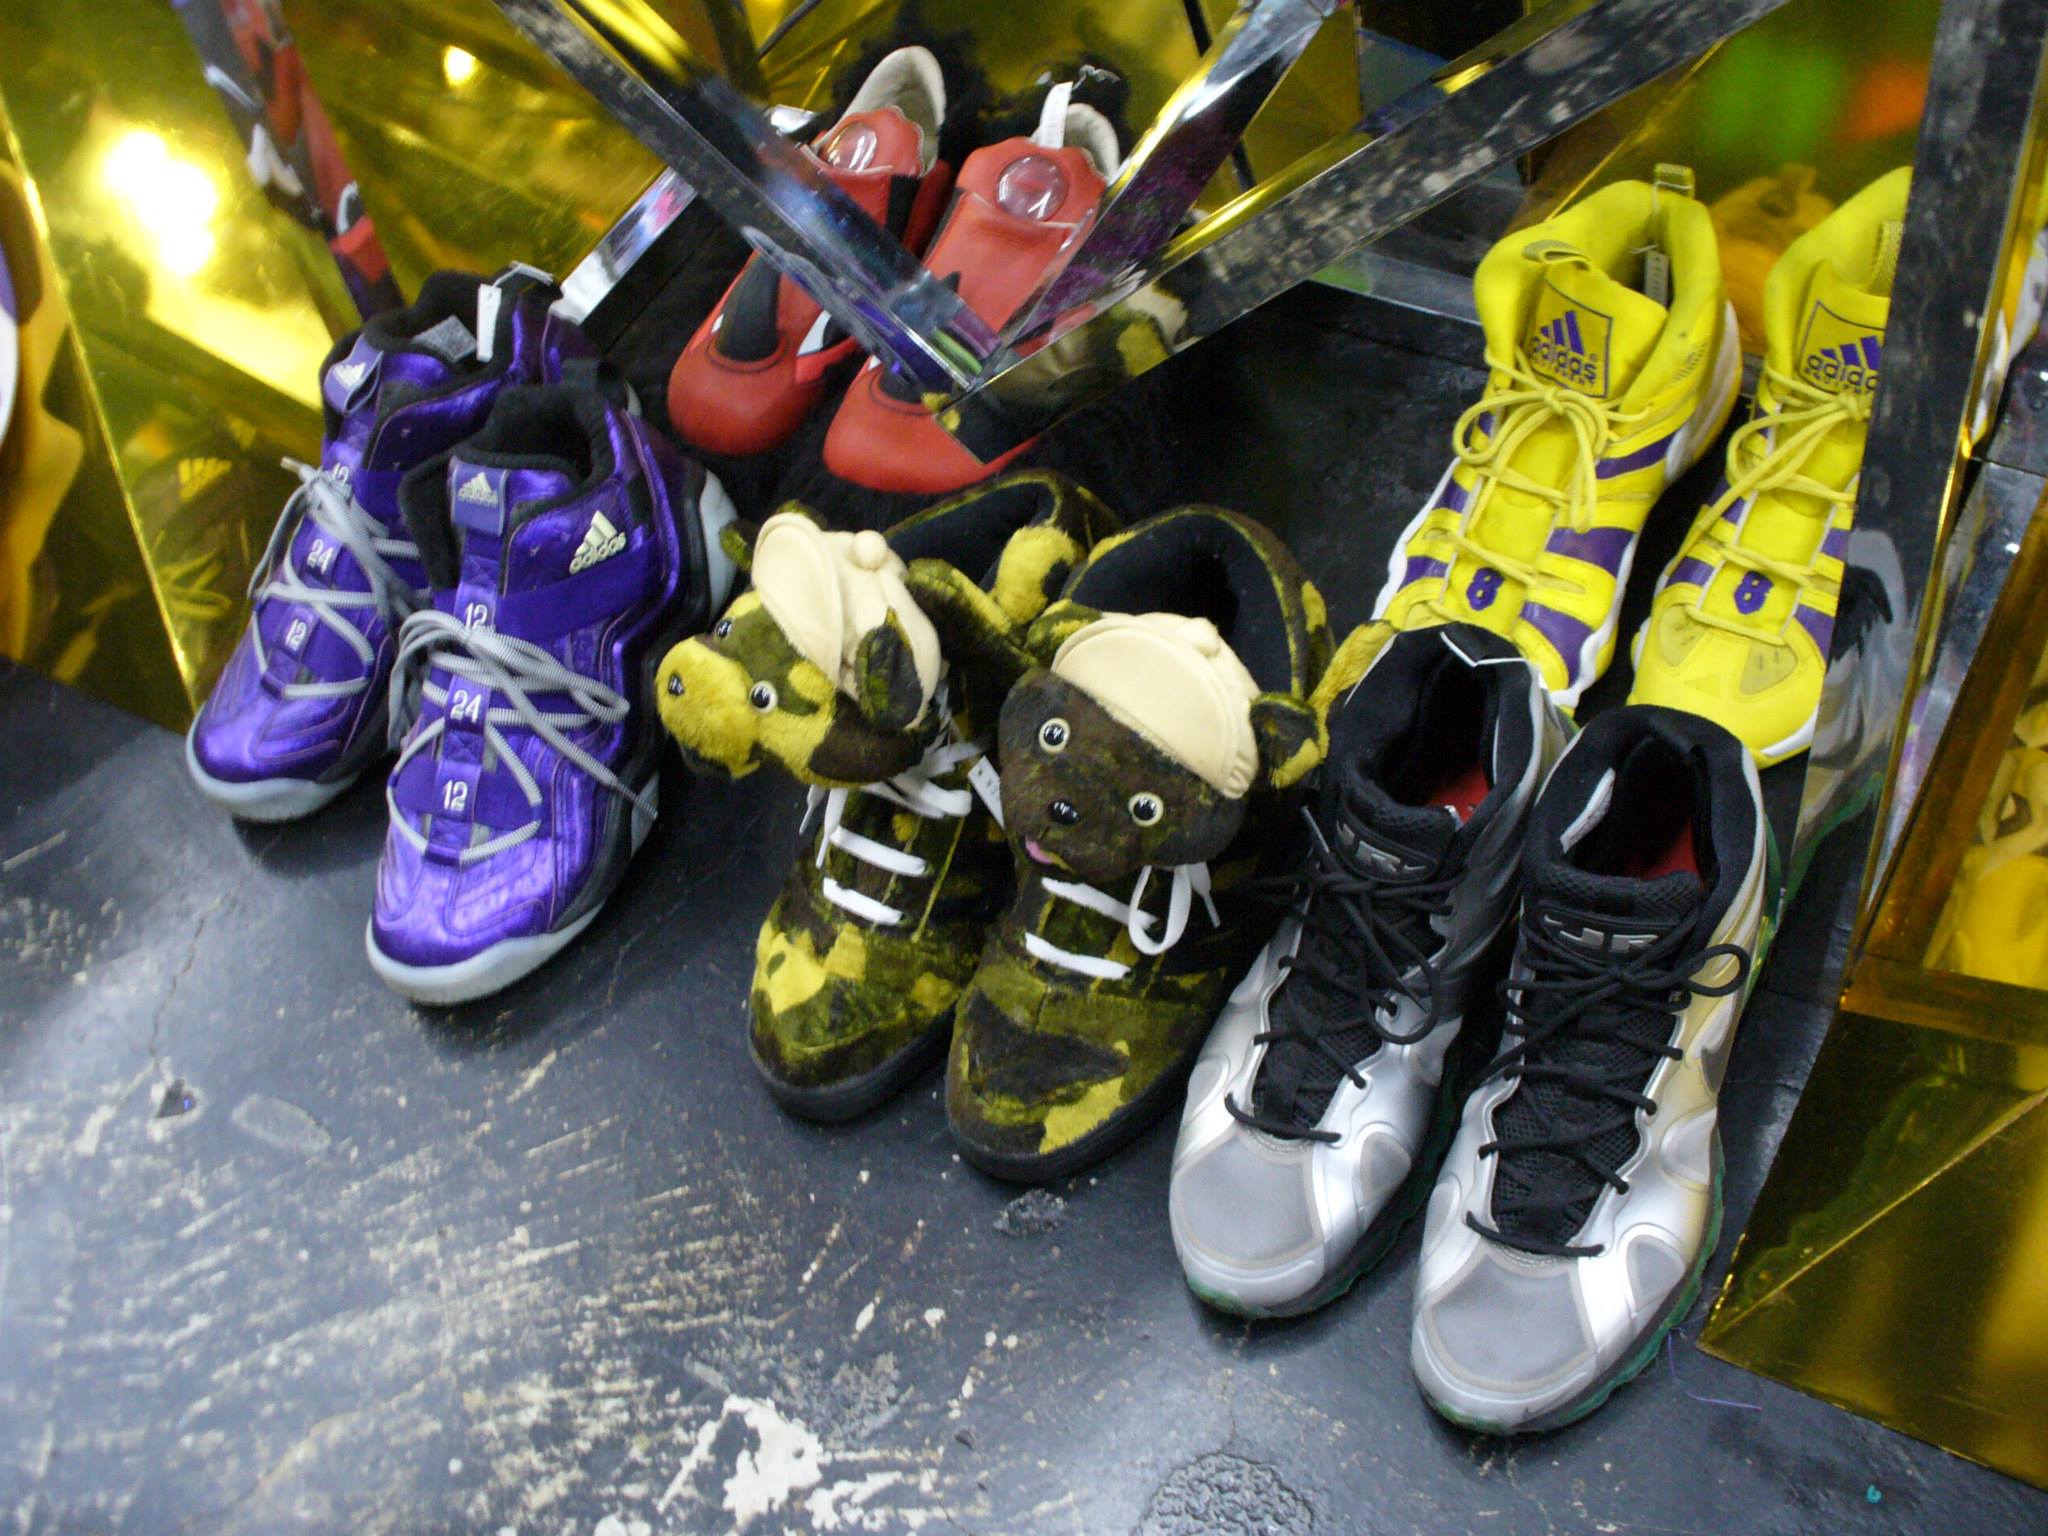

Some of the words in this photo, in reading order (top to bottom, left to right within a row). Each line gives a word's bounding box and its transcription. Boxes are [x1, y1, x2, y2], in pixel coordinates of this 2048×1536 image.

[1807, 353, 1880, 391] adida
[307, 538, 335, 575] 24
[568, 531, 628, 575] adidas
[1466, 566, 1505, 612] 8
[1733, 569, 1775, 616] 8
[464, 601, 489, 630] 12
[285, 617, 308, 652] 12
[450, 689, 482, 724] 24
[442, 779, 469, 813] 12
